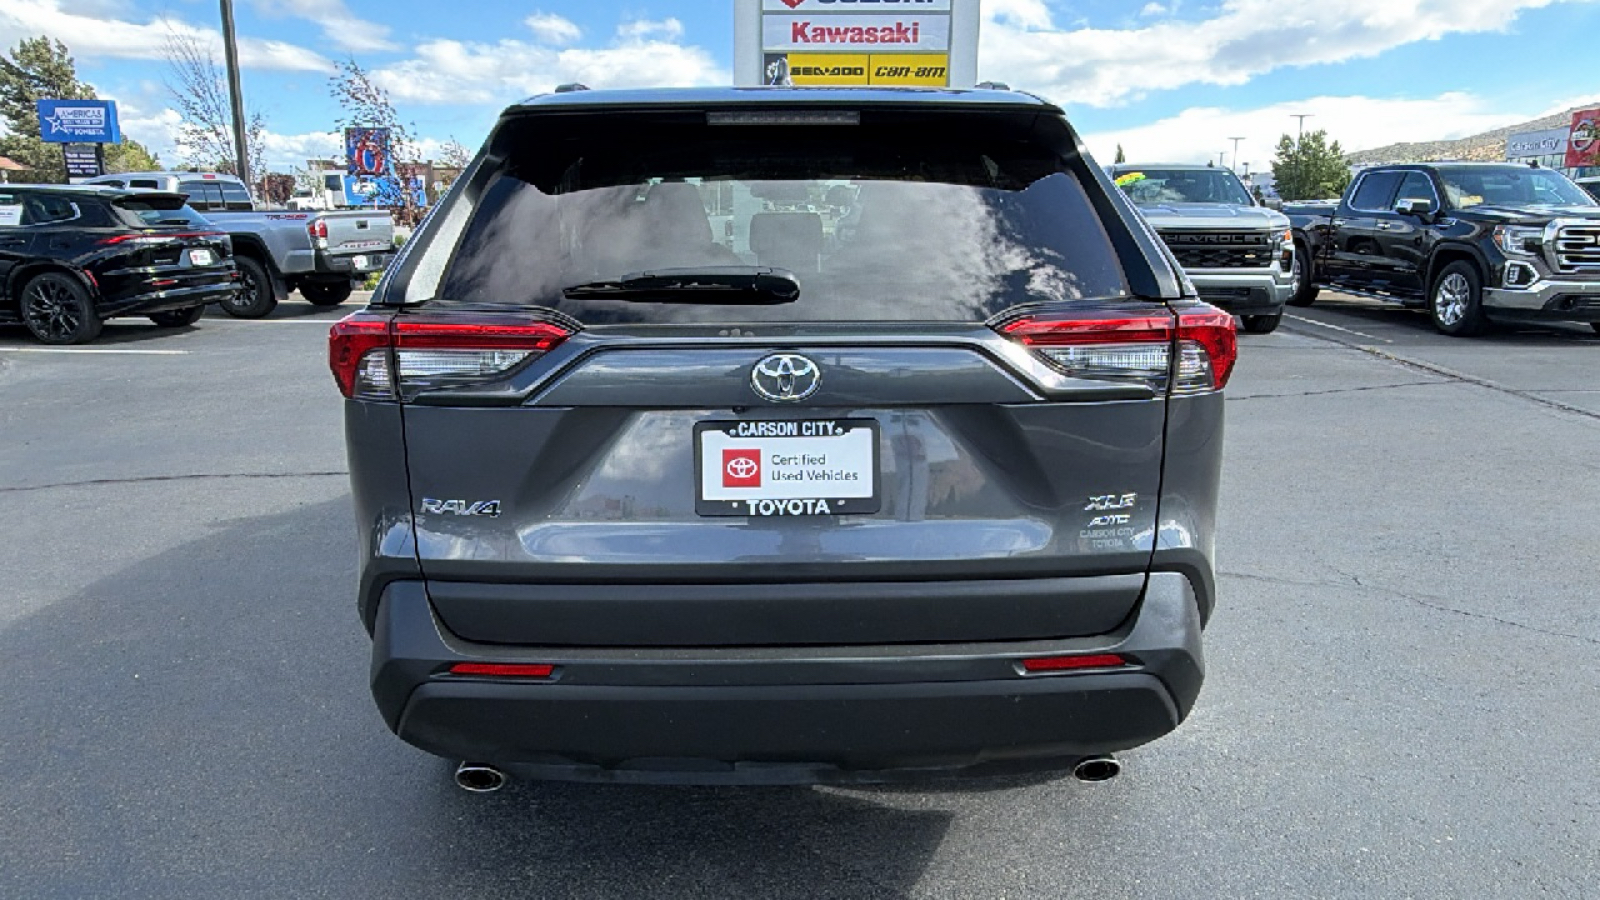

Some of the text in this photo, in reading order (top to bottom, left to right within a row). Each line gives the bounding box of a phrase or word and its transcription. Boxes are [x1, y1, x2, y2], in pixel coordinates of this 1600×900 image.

[791, 22, 919, 44] Kawasaki
[1510, 137, 1560, 151] Carson City
[738, 421, 836, 436] CARSON CITY
[771, 454, 826, 465] Certified
[771, 469, 858, 481] Used Vehicles
[420, 498, 502, 518] RAV4
[746, 499, 831, 516] TOYOTA
[1084, 492, 1138, 510] XLE
[1080, 527, 1135, 538] CARSON CITY
[1092, 539, 1123, 548] TOYOTA
